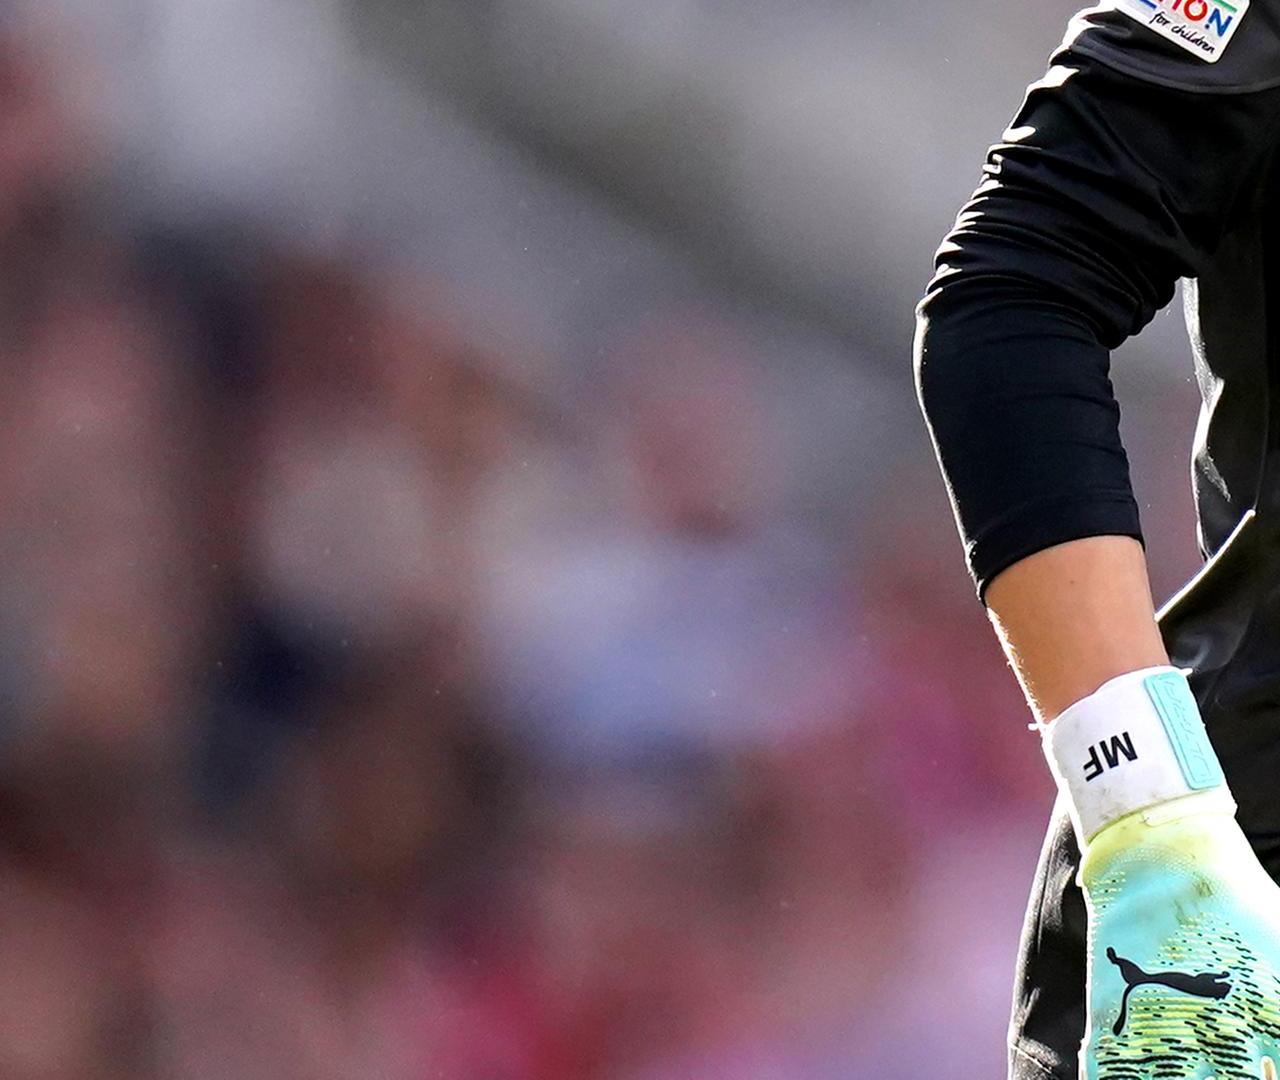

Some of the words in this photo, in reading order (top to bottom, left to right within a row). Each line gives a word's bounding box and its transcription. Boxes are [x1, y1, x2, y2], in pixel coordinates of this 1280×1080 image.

[1149, 11, 1170, 25] for
[1170, 24, 1215, 54] children
[1083, 731, 1138, 782] MF
